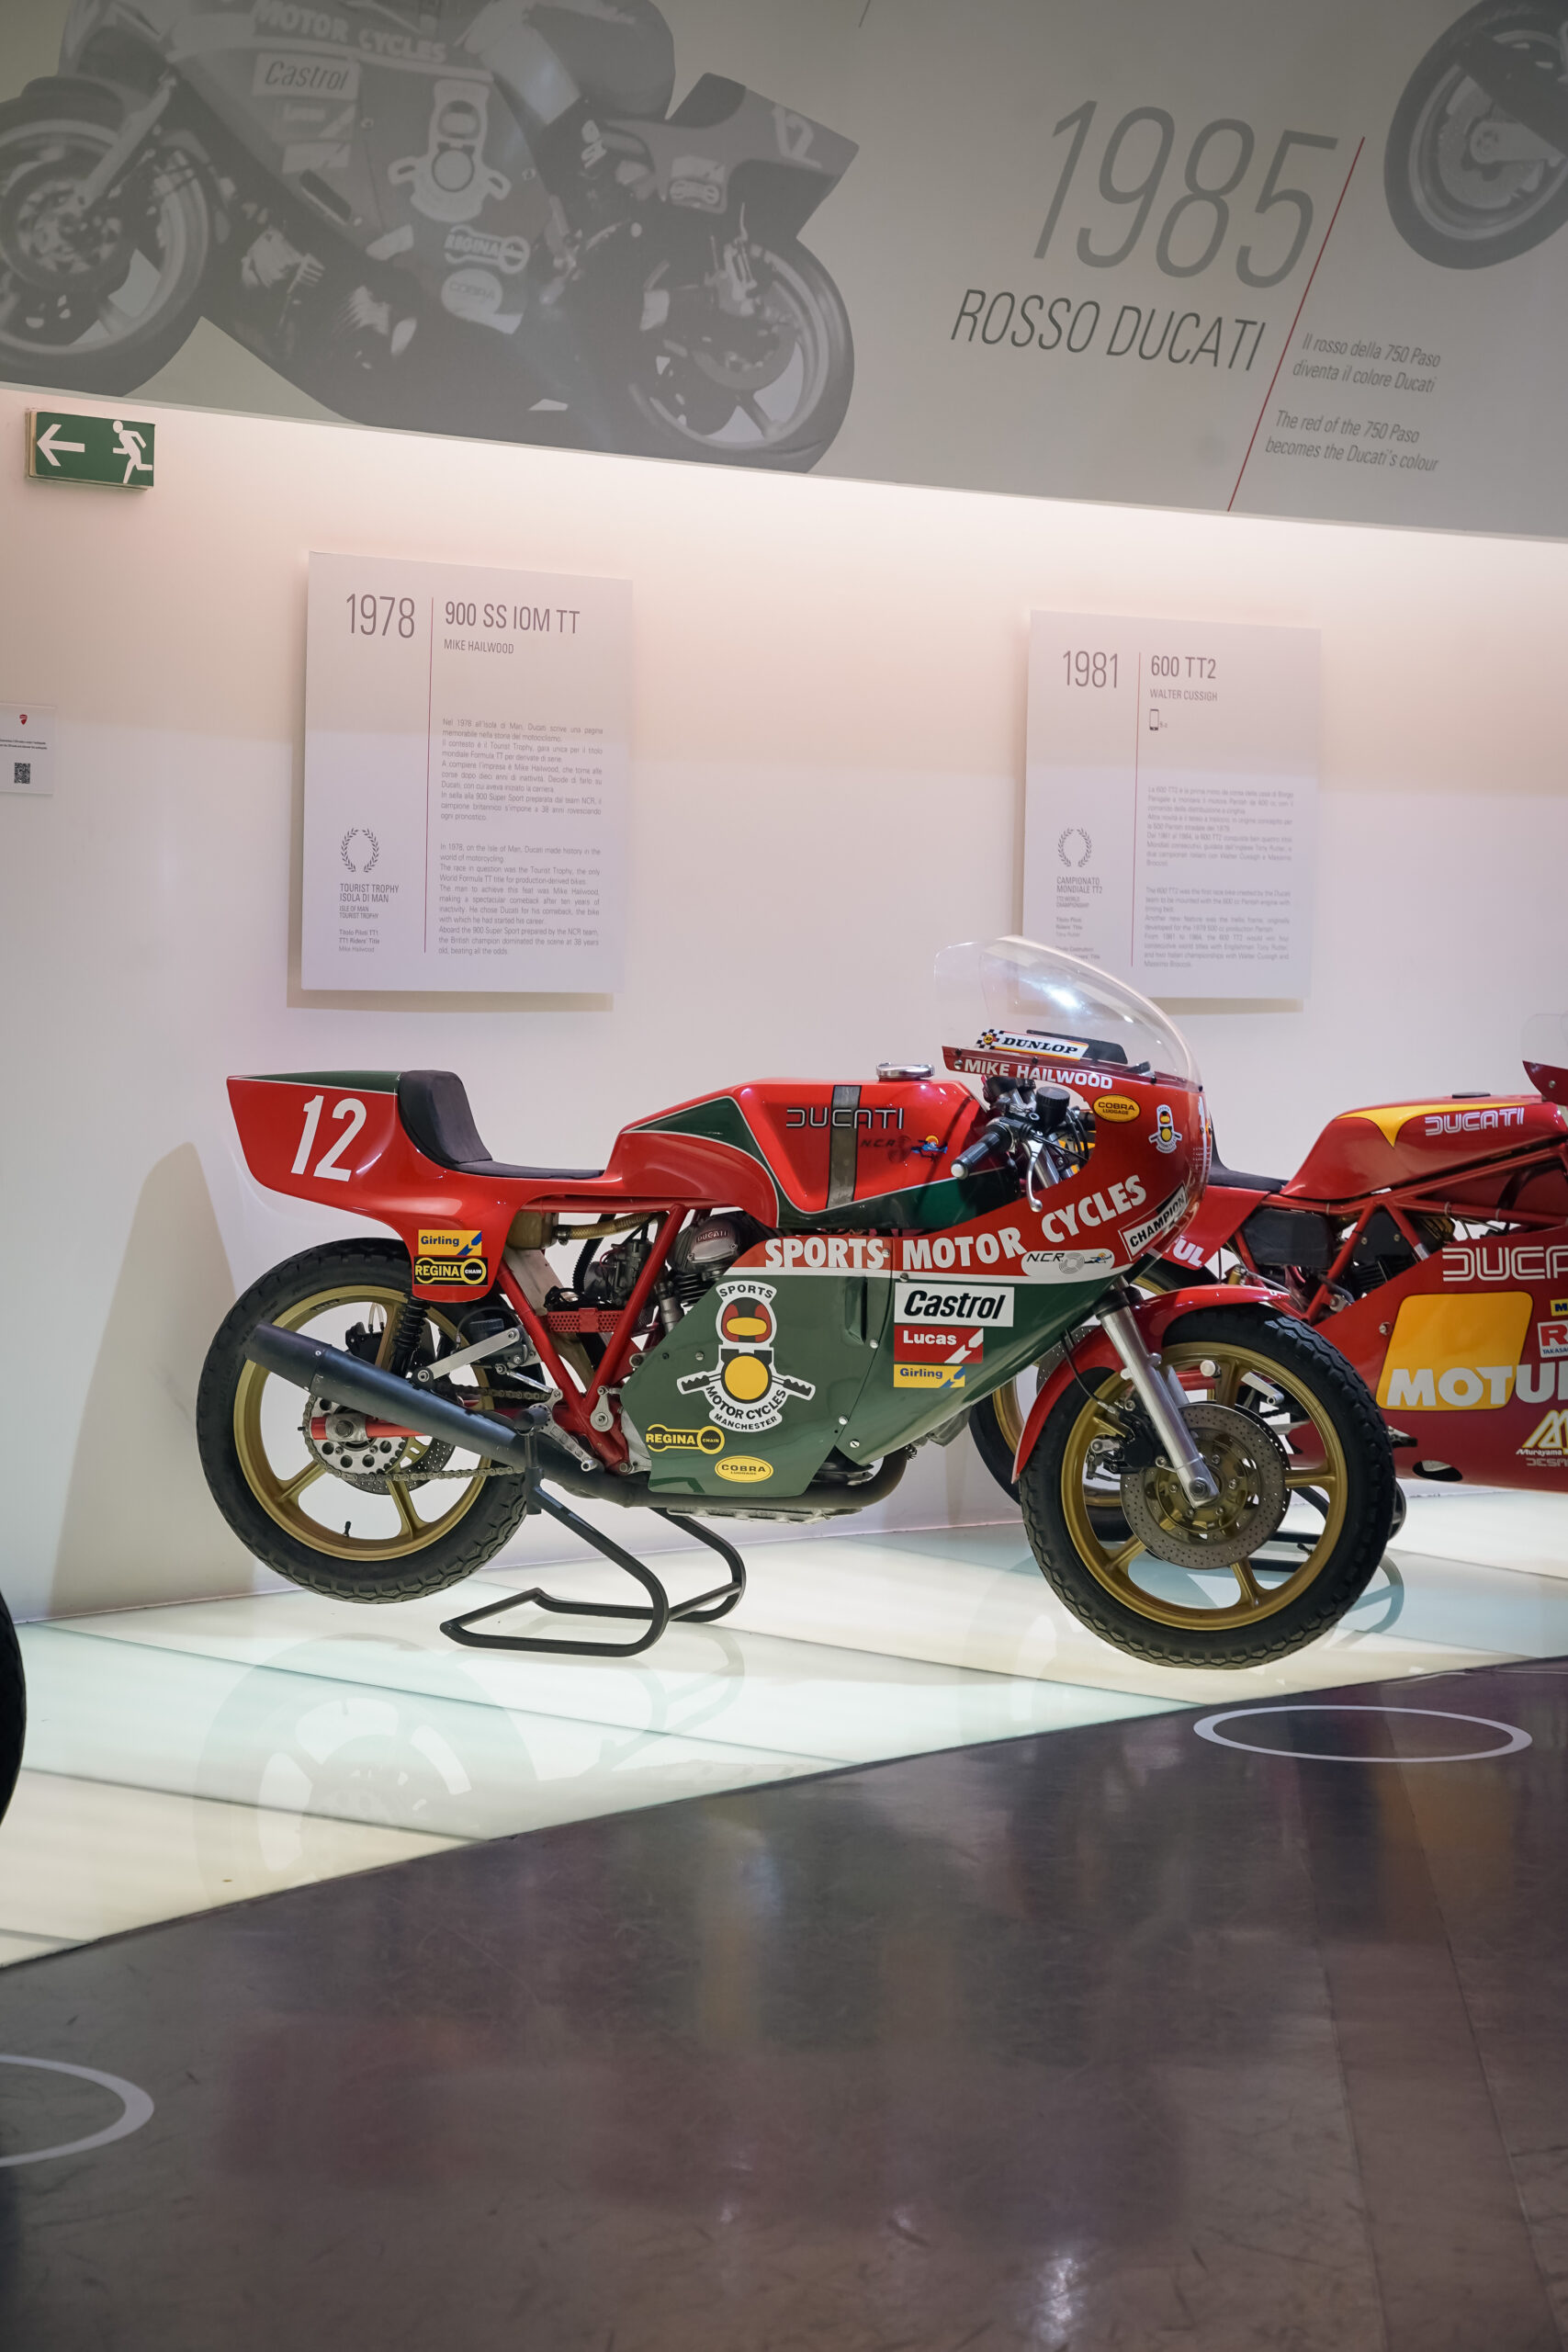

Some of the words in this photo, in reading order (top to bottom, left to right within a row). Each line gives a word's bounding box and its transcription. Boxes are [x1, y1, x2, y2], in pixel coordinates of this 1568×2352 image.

[358, 28, 447, 63] CYCLES
[265, 61, 349, 91] Castrol
[1033, 99, 1339, 288] 1985
[951, 288, 1100, 355] ROSSO
[1107, 305, 1267, 371] DUCATI
[1302, 333, 1313, 350] Il
[1313, 337, 1348, 356] rosso
[1350, 340, 1382, 359] della
[1384, 344, 1409, 363] 750
[1410, 347, 1441, 368] Paso
[1292, 359, 1339, 381] diventa
[1342, 365, 1352, 382] il
[1353, 368, 1393, 388] colore
[1394, 371, 1437, 392] Ducati
[1276, 410, 1299, 429] The
[1301, 415, 1324, 433] red
[1325, 416, 1341, 433] of
[1341, 418, 1361, 436] the
[1364, 421, 1389, 439] 750
[1389, 424, 1420, 444] Paso
[1265, 436, 1321, 458] becomes
[1324, 443, 1345, 460] the
[1347, 445, 1397, 467] Ducati's
[1399, 454, 1438, 471] colour
[345, 593, 415, 639] 1978
[445, 601, 477, 627] 900
[482, 603, 507, 629] SS
[513, 605, 550, 632] IOM
[556, 609, 581, 634] TT
[444, 639, 466, 651] MIKE
[468, 640, 514, 654] HAILWOOD
[1062, 650, 1118, 688] 1981
[1151, 655, 1179, 677] 600
[1185, 656, 1216, 679] TT2
[1149, 689, 1182, 699] WALTER
[1183, 690, 1218, 701] CUSSIGH
[545, 846, 561, 854] made
[563, 847, 582, 856] history
[440, 864, 451, 872] The
[476, 865, 502, 875] question
[588, 868, 600, 877] only
[440, 874, 458, 882] World
[458, 875, 483, 883] Formula
[340, 883, 369, 892] TOURIST
[372, 884, 399, 893] TROPHY
[1056, 876, 1100, 885] CAMPIONATO
[1056, 885, 1090, 894] MONDIALE
[1092, 886, 1102, 894] TT2
[340, 893, 360, 902] ISOLA
[362, 893, 370, 902] DI
[371, 894, 389, 903] MAN
[485, 927, 502, 936] Super
[504, 927, 520, 936] Sport
[521, 927, 547, 936] prepared
[471, 937, 501, 946] champion
[1001, 1037, 1078, 1055] DUNLOP
[964, 1058, 1010, 1076] MIKE
[1016, 1065, 1113, 1090] HAILWOOD
[1098, 1102, 1135, 1111] COBRA
[786, 1106, 905, 1130] DUCATI
[1425, 1107, 1525, 1136] DUCATI
[290, 1095, 367, 1182] 12
[764, 1237, 886, 1272] SPORTS
[902, 1226, 1028, 1272] MOTOR
[1041, 1174, 1147, 1243] CYCLES
[1129, 1193, 1187, 1249] CHAMPION
[421, 1236, 459, 1247] Girling
[415, 1265, 460, 1277] REGINA
[719, 1284, 773, 1299] SPORTS
[904, 1290, 1006, 1319] Castrol
[903, 1329, 957, 1345] Lucas
[900, 1368, 943, 1379] Girling
[705, 1385, 745, 1419] MOTOR
[746, 1389, 786, 1419] CYCLES
[714, 1413, 778, 1430] MANCHESTER
[646, 1433, 696, 1444] REGINA
[1516, 1448, 1562, 1457] Murayama
[721, 1464, 766, 1472] COBRA
